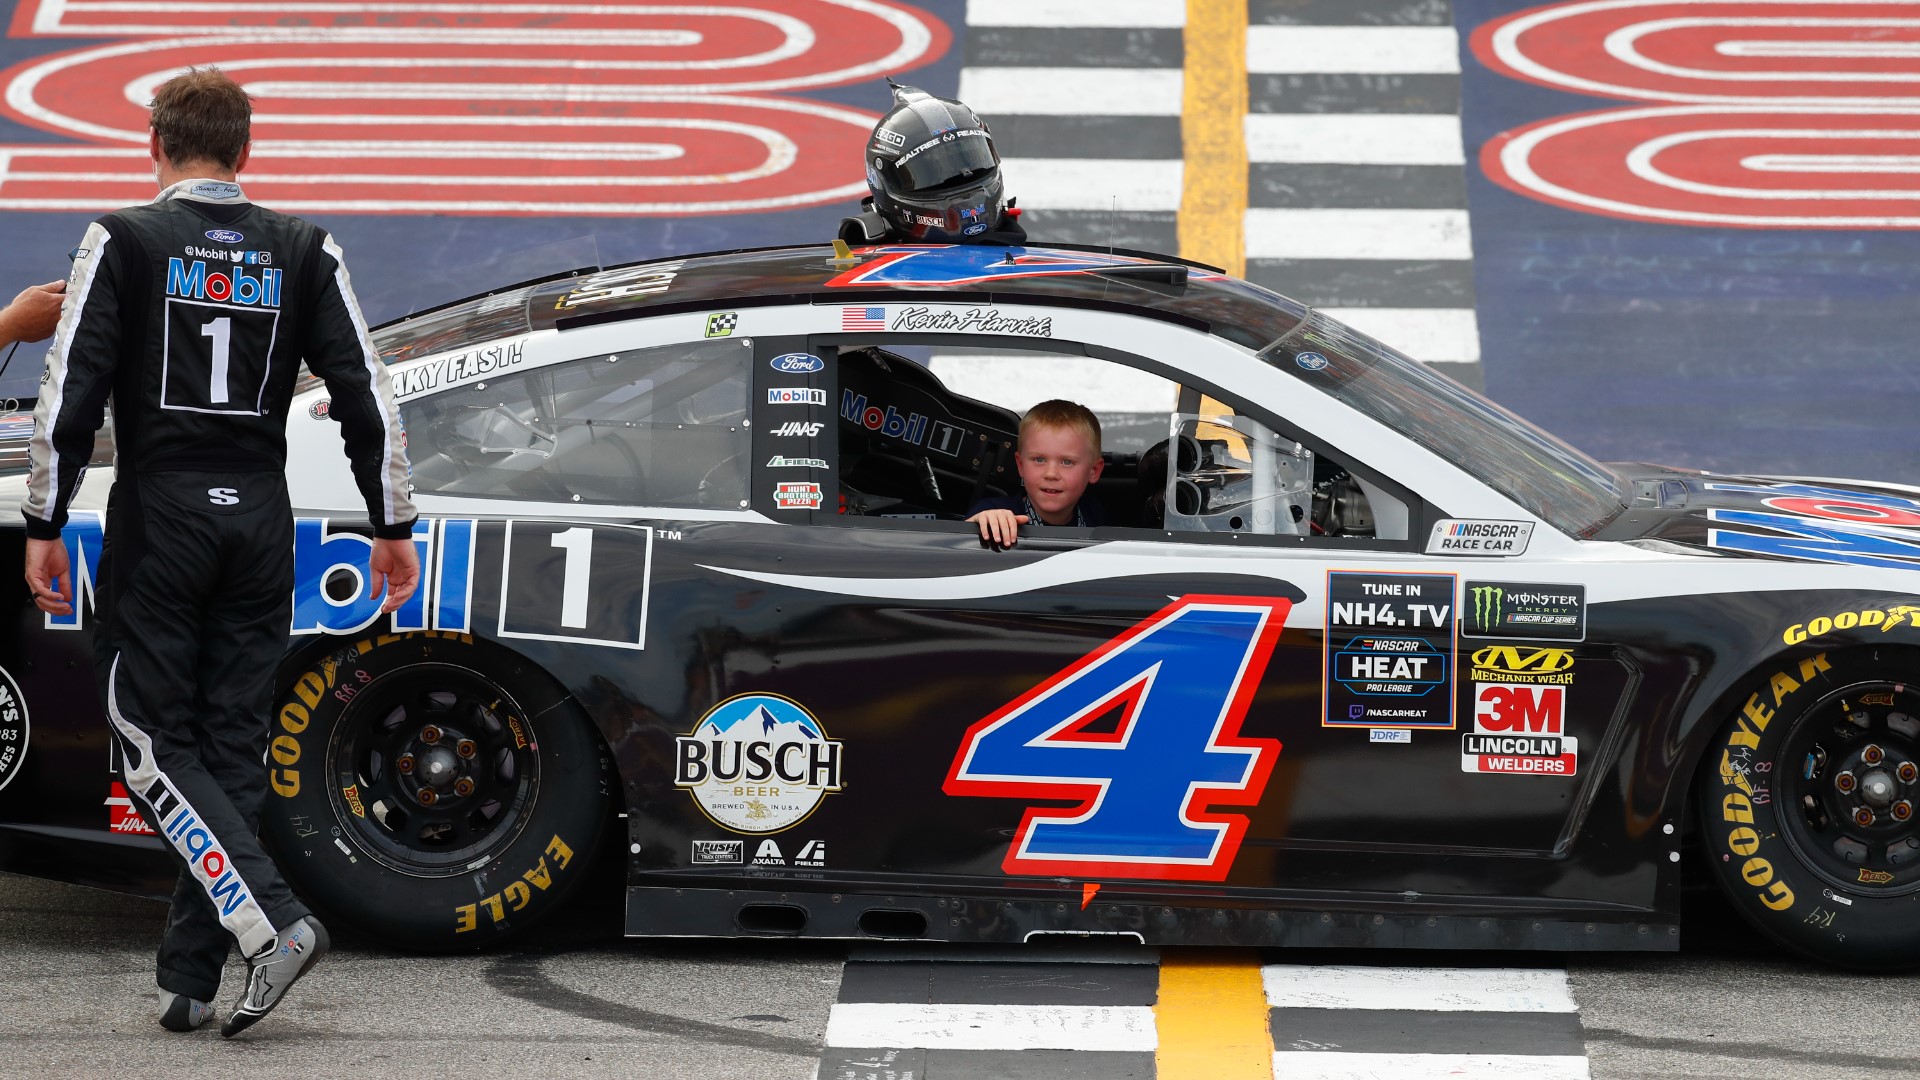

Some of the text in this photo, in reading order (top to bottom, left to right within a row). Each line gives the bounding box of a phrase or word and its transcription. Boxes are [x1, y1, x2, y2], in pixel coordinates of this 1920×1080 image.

[895, 137, 941, 169] REALTREE
[916, 215, 945, 228] BUSCH
[212, 230, 236, 242] Ford
[185, 245, 229, 261] @Mobil1
[166, 256, 282, 308] Mobil
[892, 307, 1052, 337] Kevin Harvick
[201, 317, 231, 404] 1
[781, 355, 815, 371] Ford
[389, 338, 528, 399] AKY FAST!
[769, 390, 809, 402] Mobil
[840, 387, 928, 446] Mobil
[940, 426, 952, 451] 1
[769, 421, 825, 437] HAAS
[784, 459, 825, 467] FIELDS
[207, 487, 240, 505] S
[778, 492, 820, 500] BROTHERS
[787, 485, 811, 493] HUNT
[1462, 523, 1519, 538] NASCAR
[1441, 538, 1514, 551] RACE CAR
[551, 526, 593, 629] 1
[657, 529, 683, 540] TM
[1361, 583, 1421, 596] TUNE IN
[1506, 592, 1579, 607] MONSTER
[1332, 601, 1450, 628] NH4.TV
[1516, 606, 1568, 614] ENERGY
[1514, 614, 1578, 624] NASCAR CUP SERIES
[1372, 639, 1420, 652] NASCAR
[1351, 656, 1428, 679] HEAT
[1470, 667, 1574, 685] MECHANIX WEAR
[1365, 683, 1414, 693] PRO LEAGUE
[1366, 708, 1428, 718] /NASCARHEAT
[1477, 686, 1563, 734] 3M
[942, 593, 1293, 881] 4
[1370, 730, 1401, 740] JDRF
[1468, 736, 1557, 755] LINCOLN
[675, 737, 843, 791] BUSCH
[1487, 757, 1565, 772] WELDERS
[732, 786, 780, 797] BEER
[711, 803, 745, 811] BREWED
[154, 789, 249, 918] Mobil 1
[751, 858, 786, 866] AXALTA
[455, 833, 574, 934] EAGLE
[1862, 873, 1888, 882] AERO
[280, 927, 305, 957] Mobil
